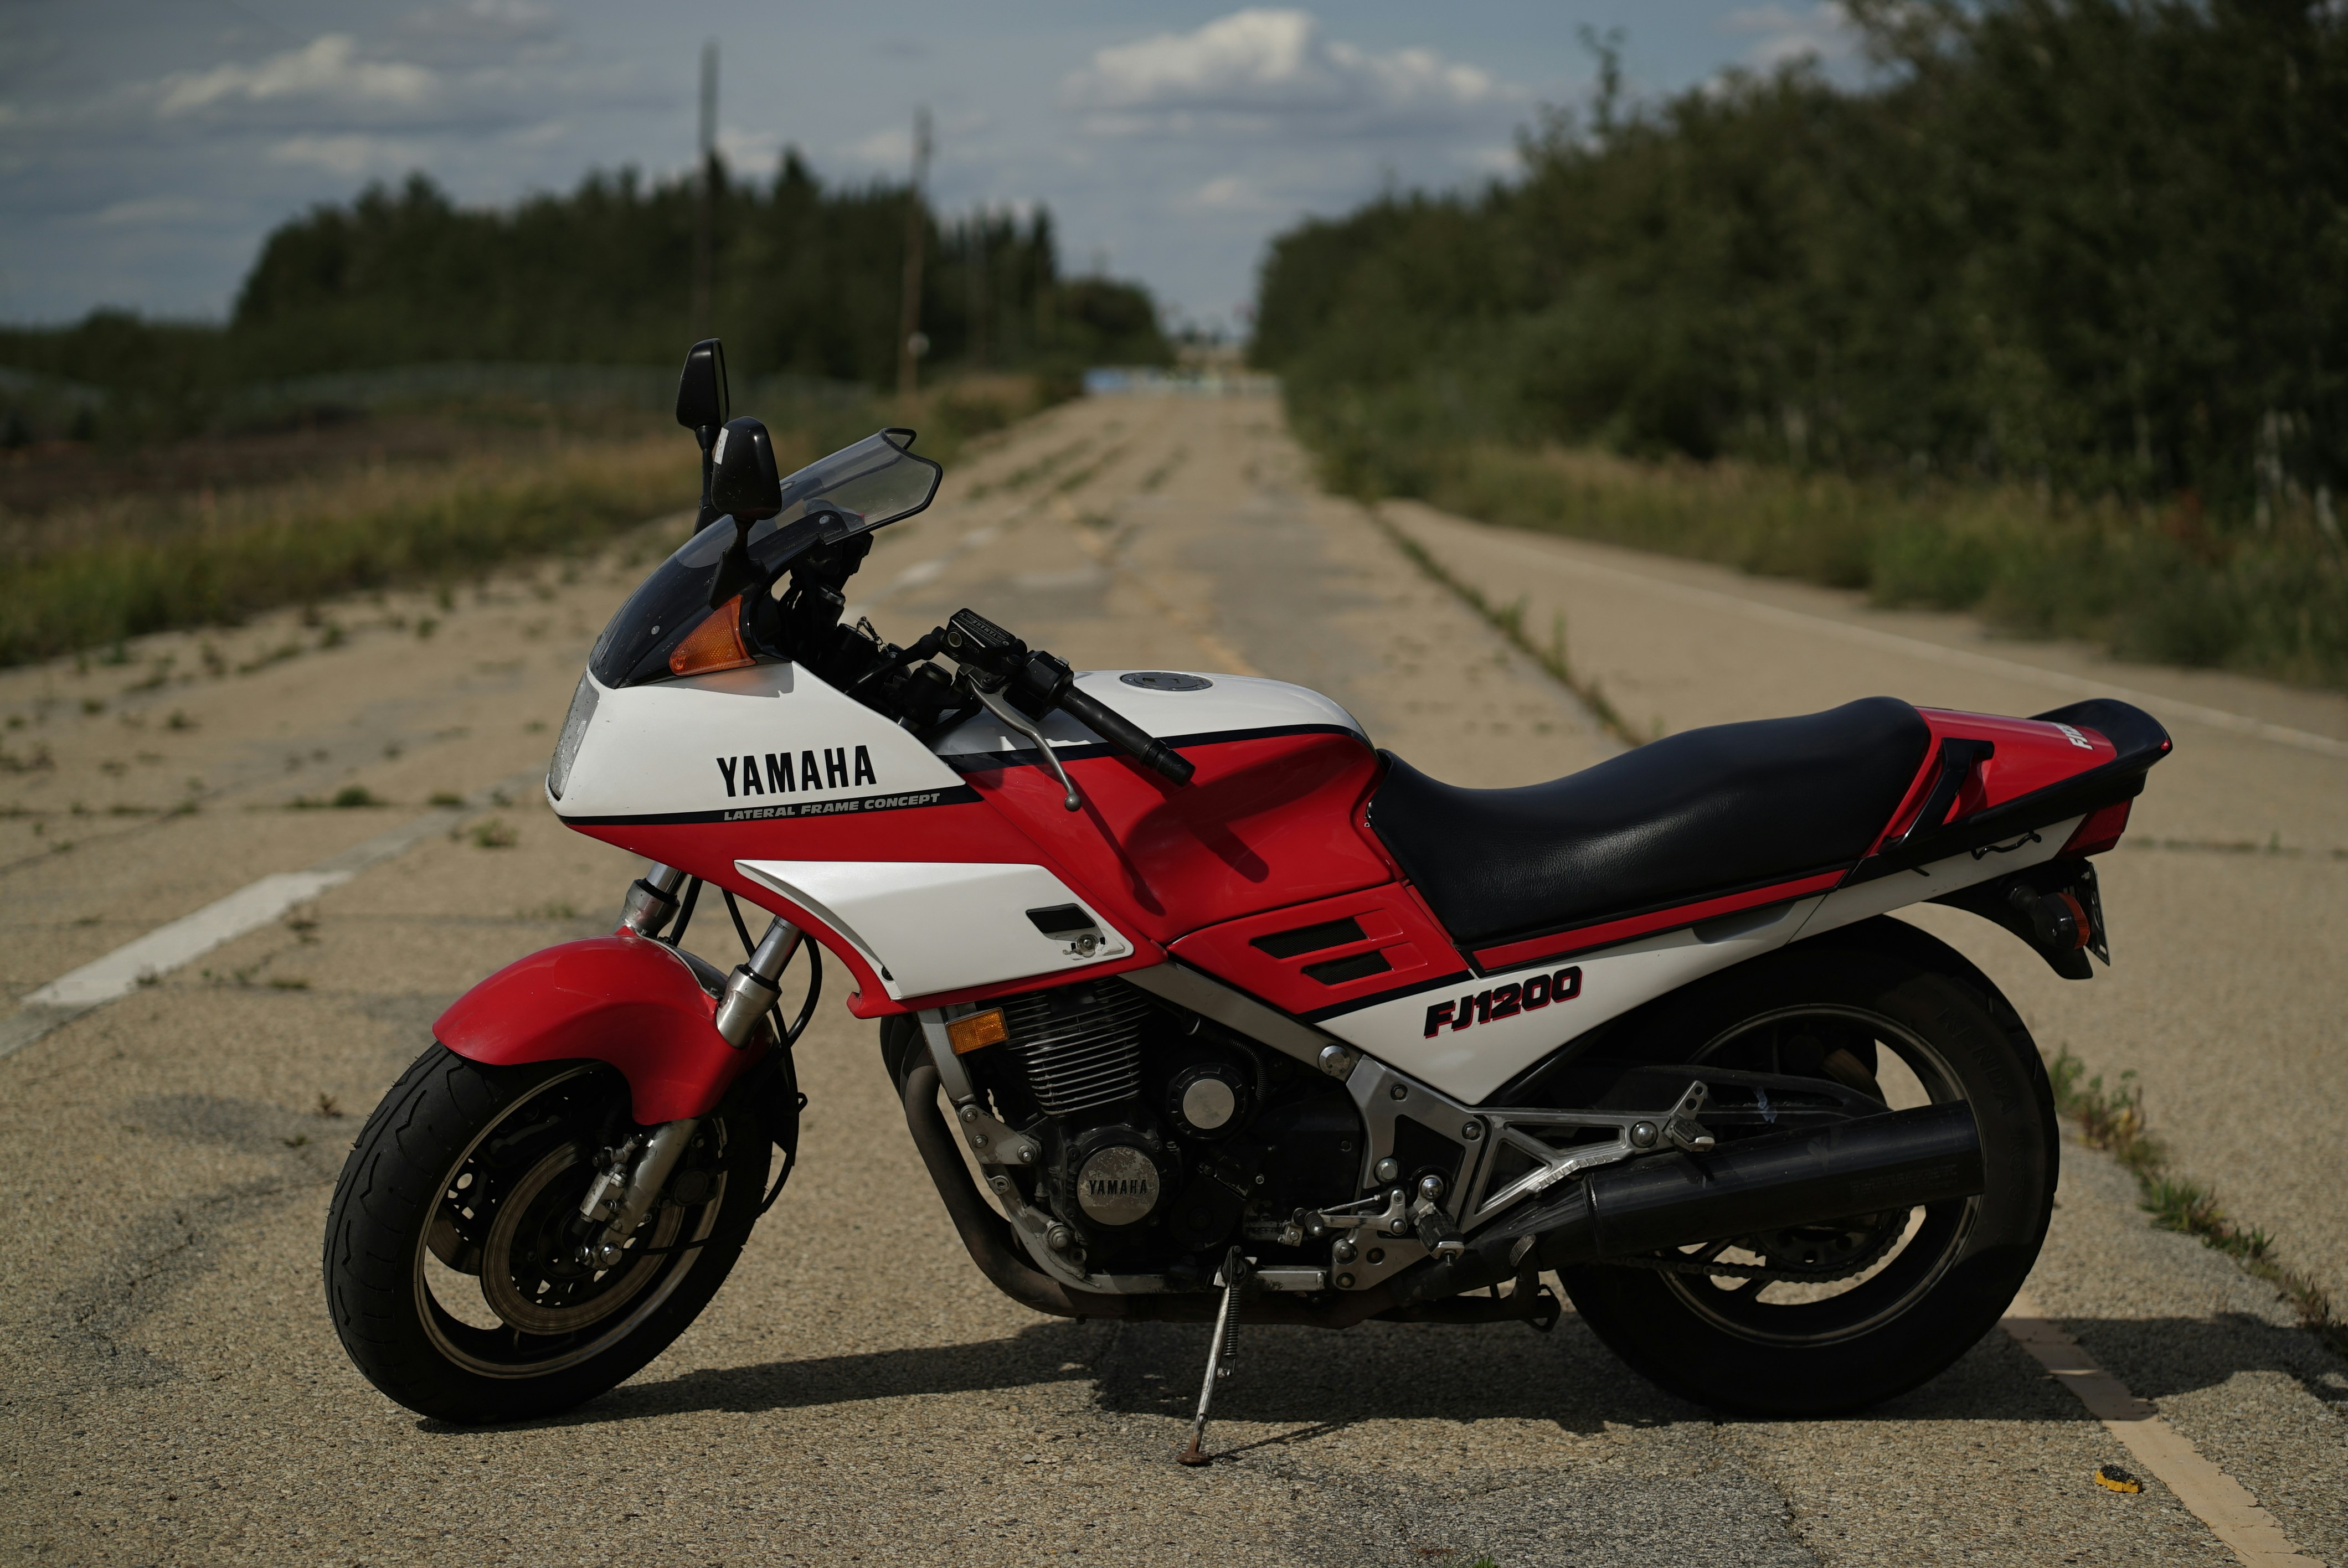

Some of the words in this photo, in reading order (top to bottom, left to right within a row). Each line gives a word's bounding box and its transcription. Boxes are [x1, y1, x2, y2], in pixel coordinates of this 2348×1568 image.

[972, 620, 997, 638] YAMAHA
[716, 745, 877, 797] YAMAHA
[724, 806, 795, 821] LATERAL
[801, 801, 859, 814] FRAME
[864, 793, 940, 809] CONCEPT
[1423, 966, 1582, 1039] FJ1200
[1935, 1006, 2022, 1116] KENDA
[1089, 1179, 1147, 1196] YAMAHA
